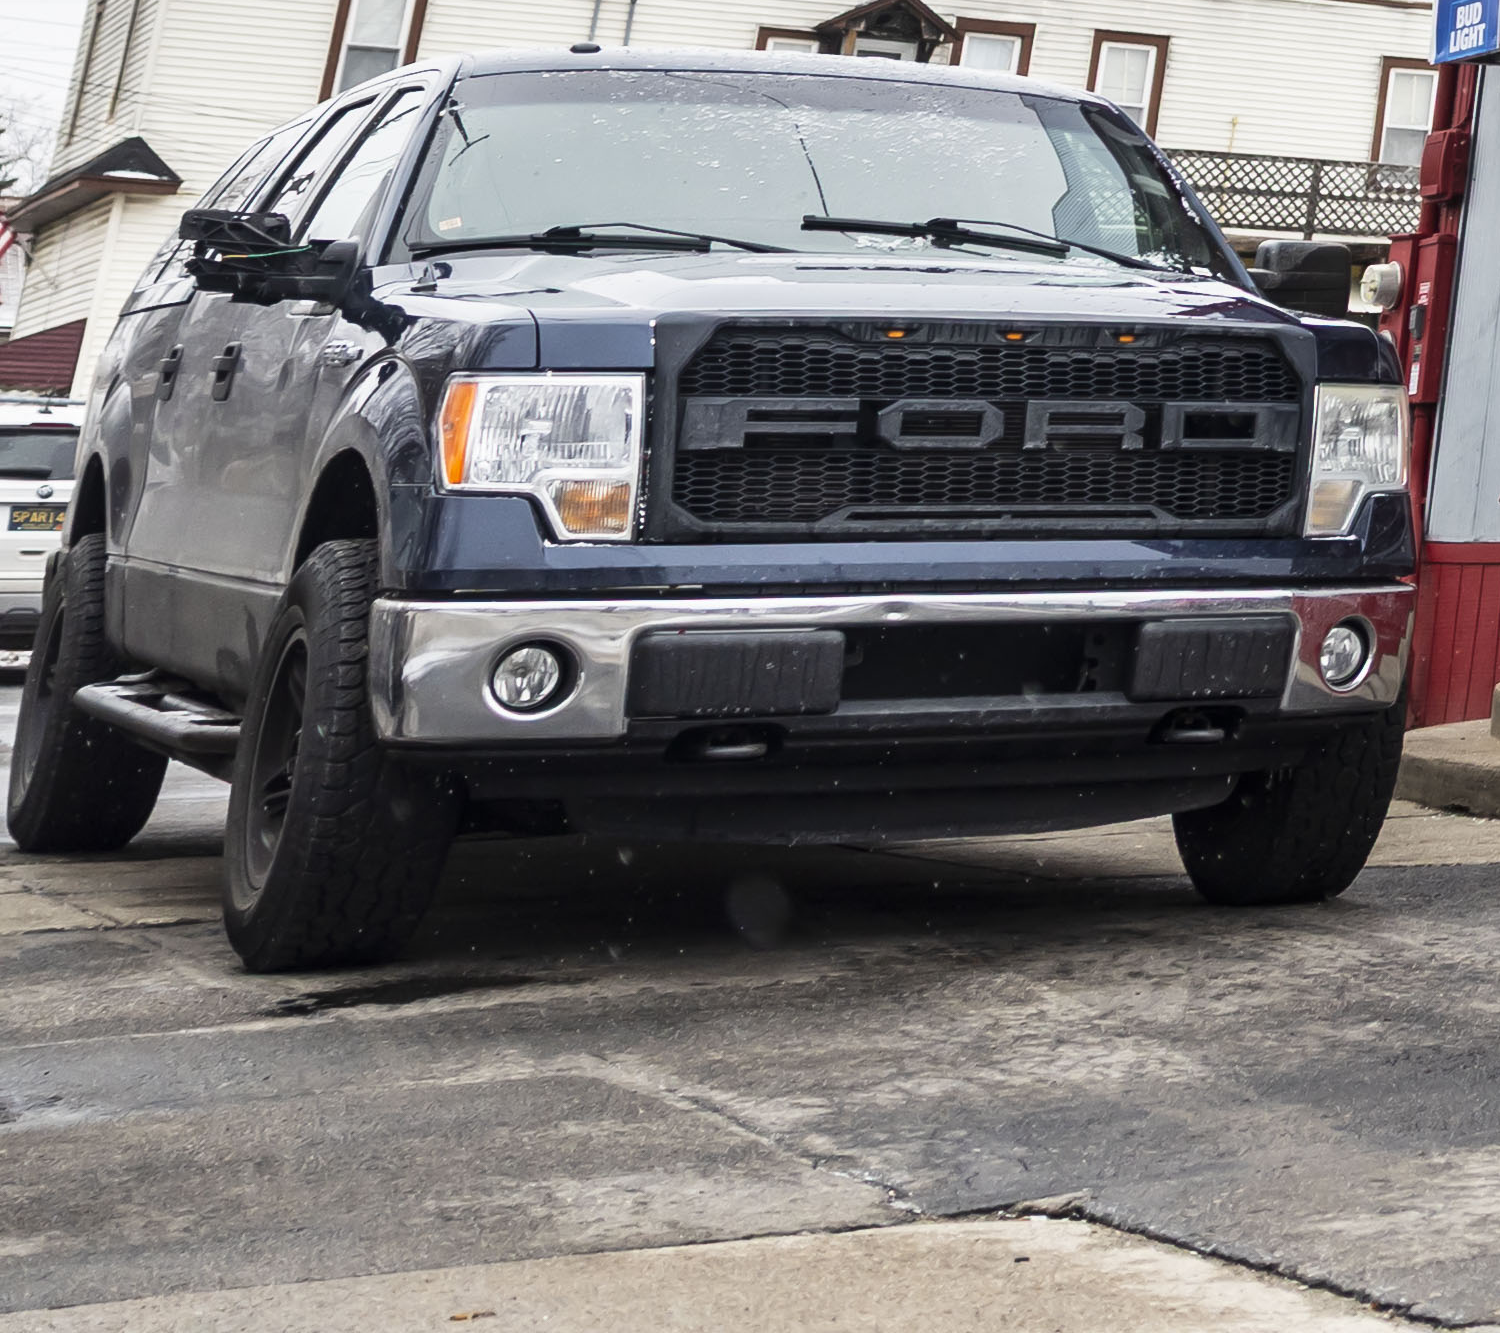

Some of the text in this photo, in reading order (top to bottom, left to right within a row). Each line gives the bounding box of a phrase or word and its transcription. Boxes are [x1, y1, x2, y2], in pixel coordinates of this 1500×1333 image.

[1456, 2, 1482, 29] BUD
[1449, 23, 1486, 53] LIGHT
[678, 398, 1301, 451] FORD
